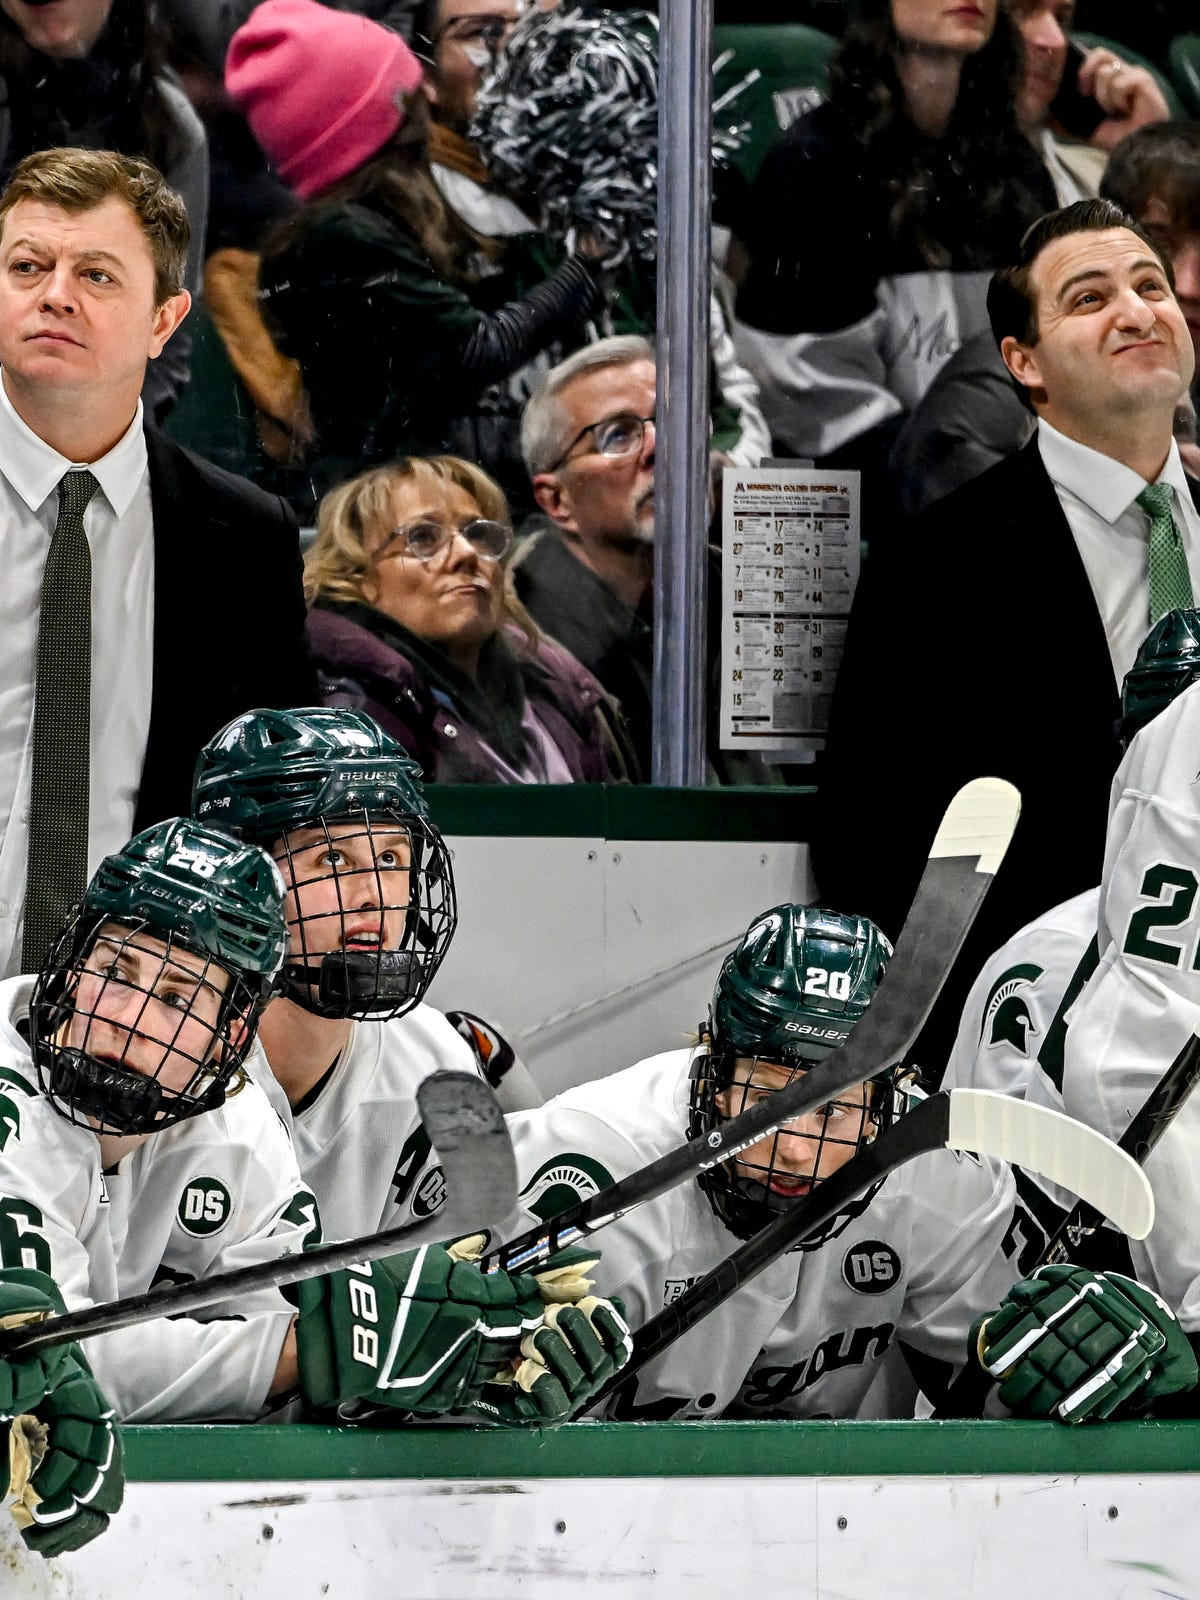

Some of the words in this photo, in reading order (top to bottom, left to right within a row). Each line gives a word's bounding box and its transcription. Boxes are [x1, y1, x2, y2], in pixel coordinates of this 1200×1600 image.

[783, 484, 808, 493] GOLDEN
[810, 485, 838, 493] GOPHERS
[775, 520, 784, 532] 17
[733, 543, 744, 555] 27
[774, 543, 784, 555] 23
[774, 567, 784, 579] 72
[813, 567, 821, 580] 11
[774, 645, 784, 658] 55
[733, 670, 743, 681] 24
[773, 669, 783, 681] 22
[733, 694, 742, 705] 15
[1122, 860, 1200, 972] 2
[804, 966, 852, 1001] 20
[418, 1169, 449, 1211] DS
[184, 1187, 225, 1222] DS
[850, 1251, 894, 1284] DS
